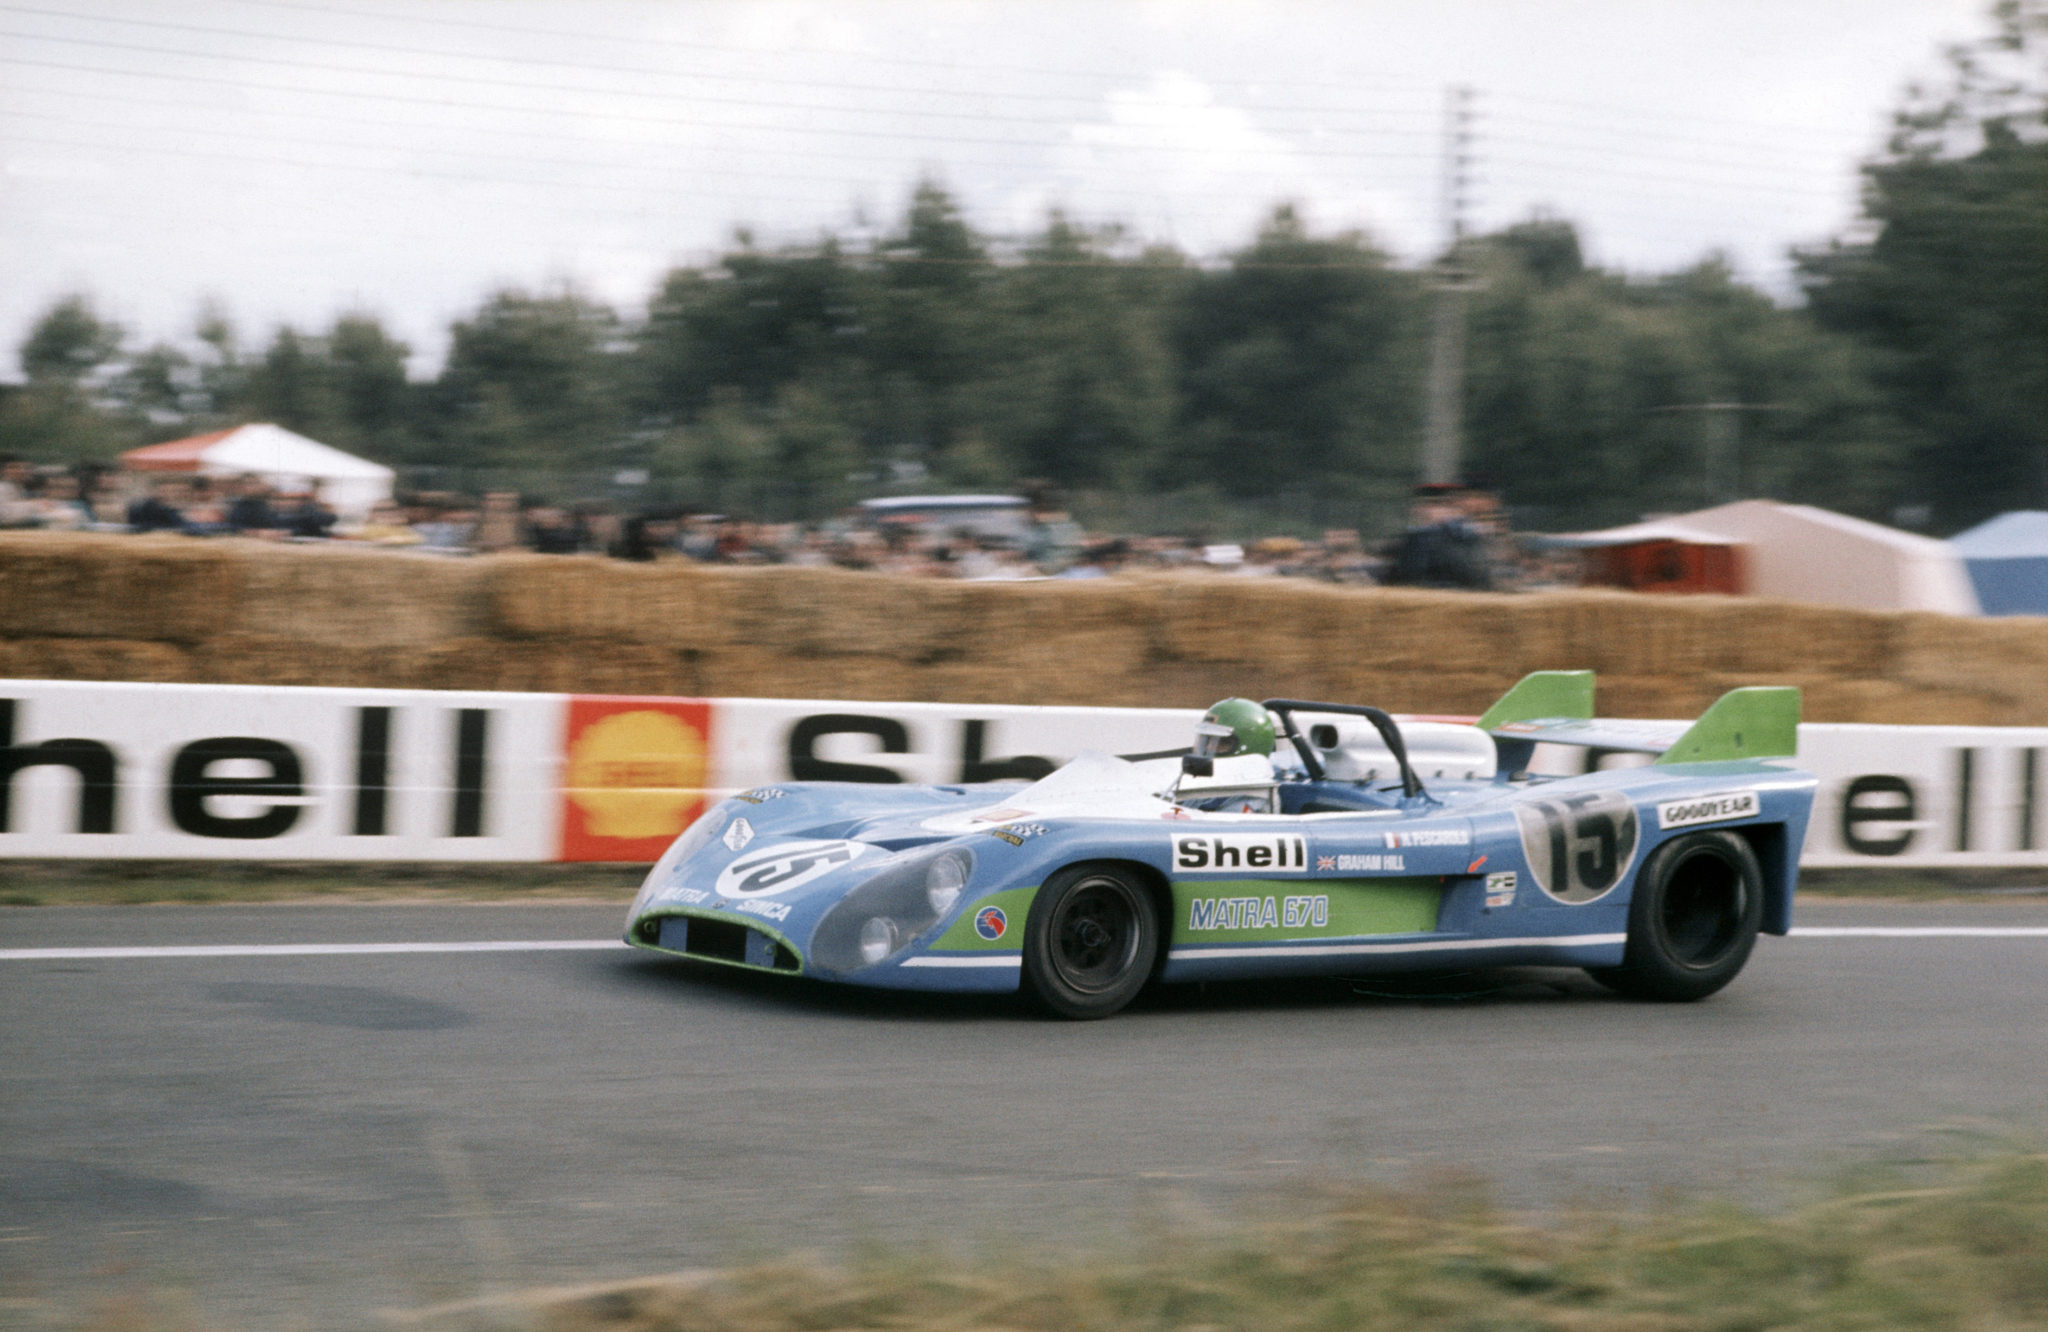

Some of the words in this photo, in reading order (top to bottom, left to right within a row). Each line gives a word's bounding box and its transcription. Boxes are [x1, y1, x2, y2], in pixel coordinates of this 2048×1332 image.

[1666, 797, 1753, 823] GOODYEAR
[1841, 747, 2038, 856] ell
[1178, 837, 1303, 868] Shell
[1535, 793, 1618, 892] 15
[733, 842, 851, 891] 15
[1338, 854, 1381, 871] GRAHAM
[1383, 854, 1405, 871] HILL
[1189, 896, 1278, 930] MATRA
[1283, 895, 1328, 927] 670
